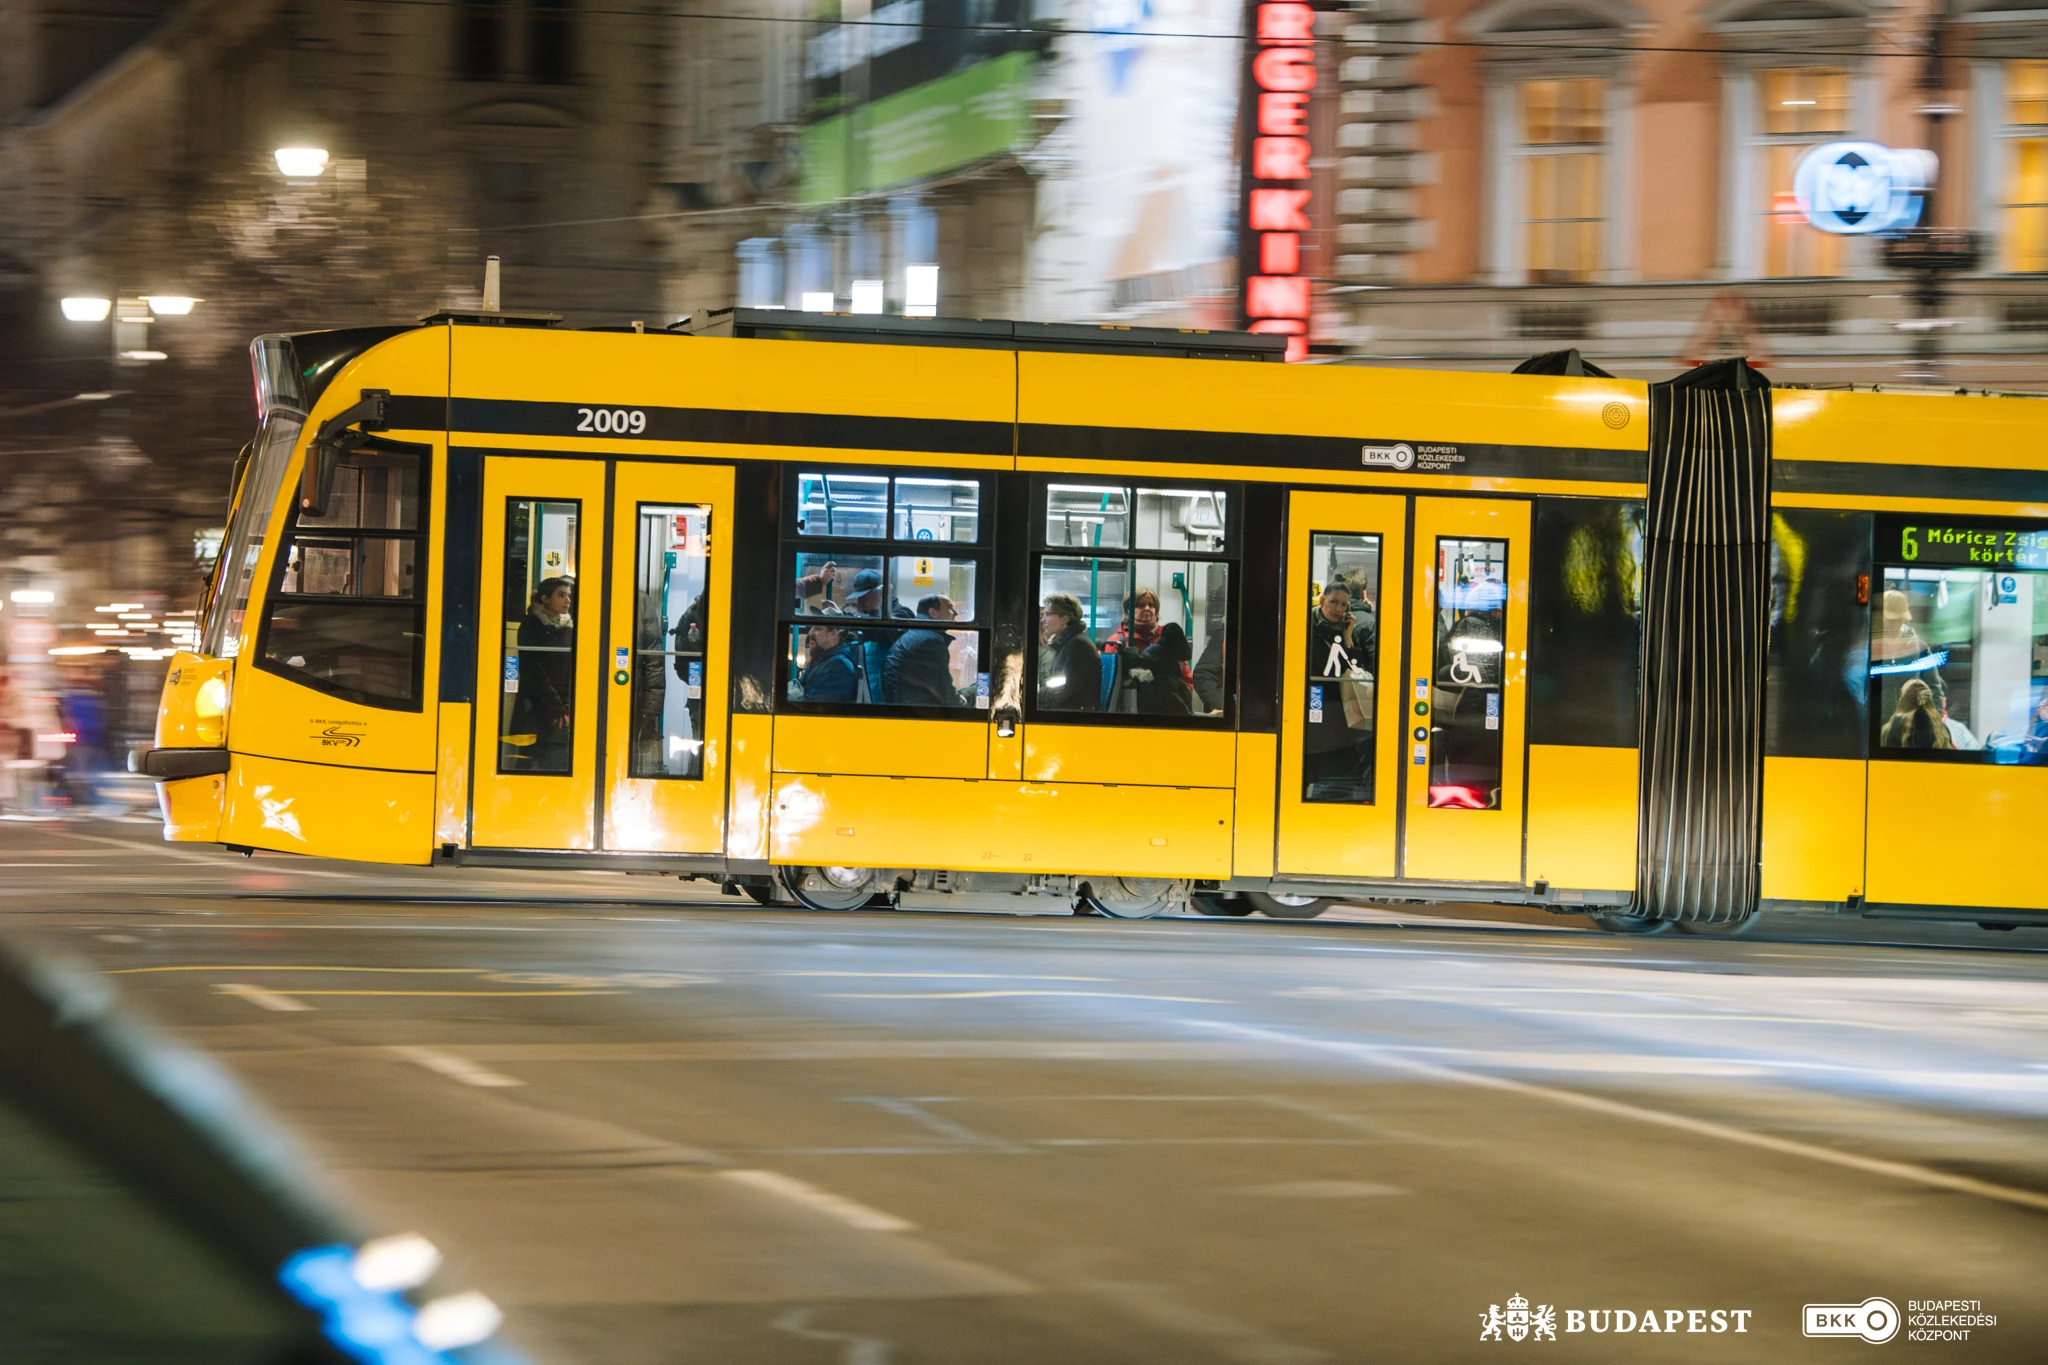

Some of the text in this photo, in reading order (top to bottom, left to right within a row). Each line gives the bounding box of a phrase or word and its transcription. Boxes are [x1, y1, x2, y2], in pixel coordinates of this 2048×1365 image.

[1253, 0, 1317, 180] RGER
[577, 408, 646, 434] 2009
[1369, 452, 1391, 460] BKK
[1417, 445, 1457, 454] BUDAPESTI
[1417, 453, 1466, 463] KÖZLEKEDÉSI
[1417, 462, 1451, 470] KÖZPONT
[1901, 526, 1918, 561] 6
[1927, 528, 2048, 549] Móricz Zsig
[1969, 547, 2038, 563] körtér
